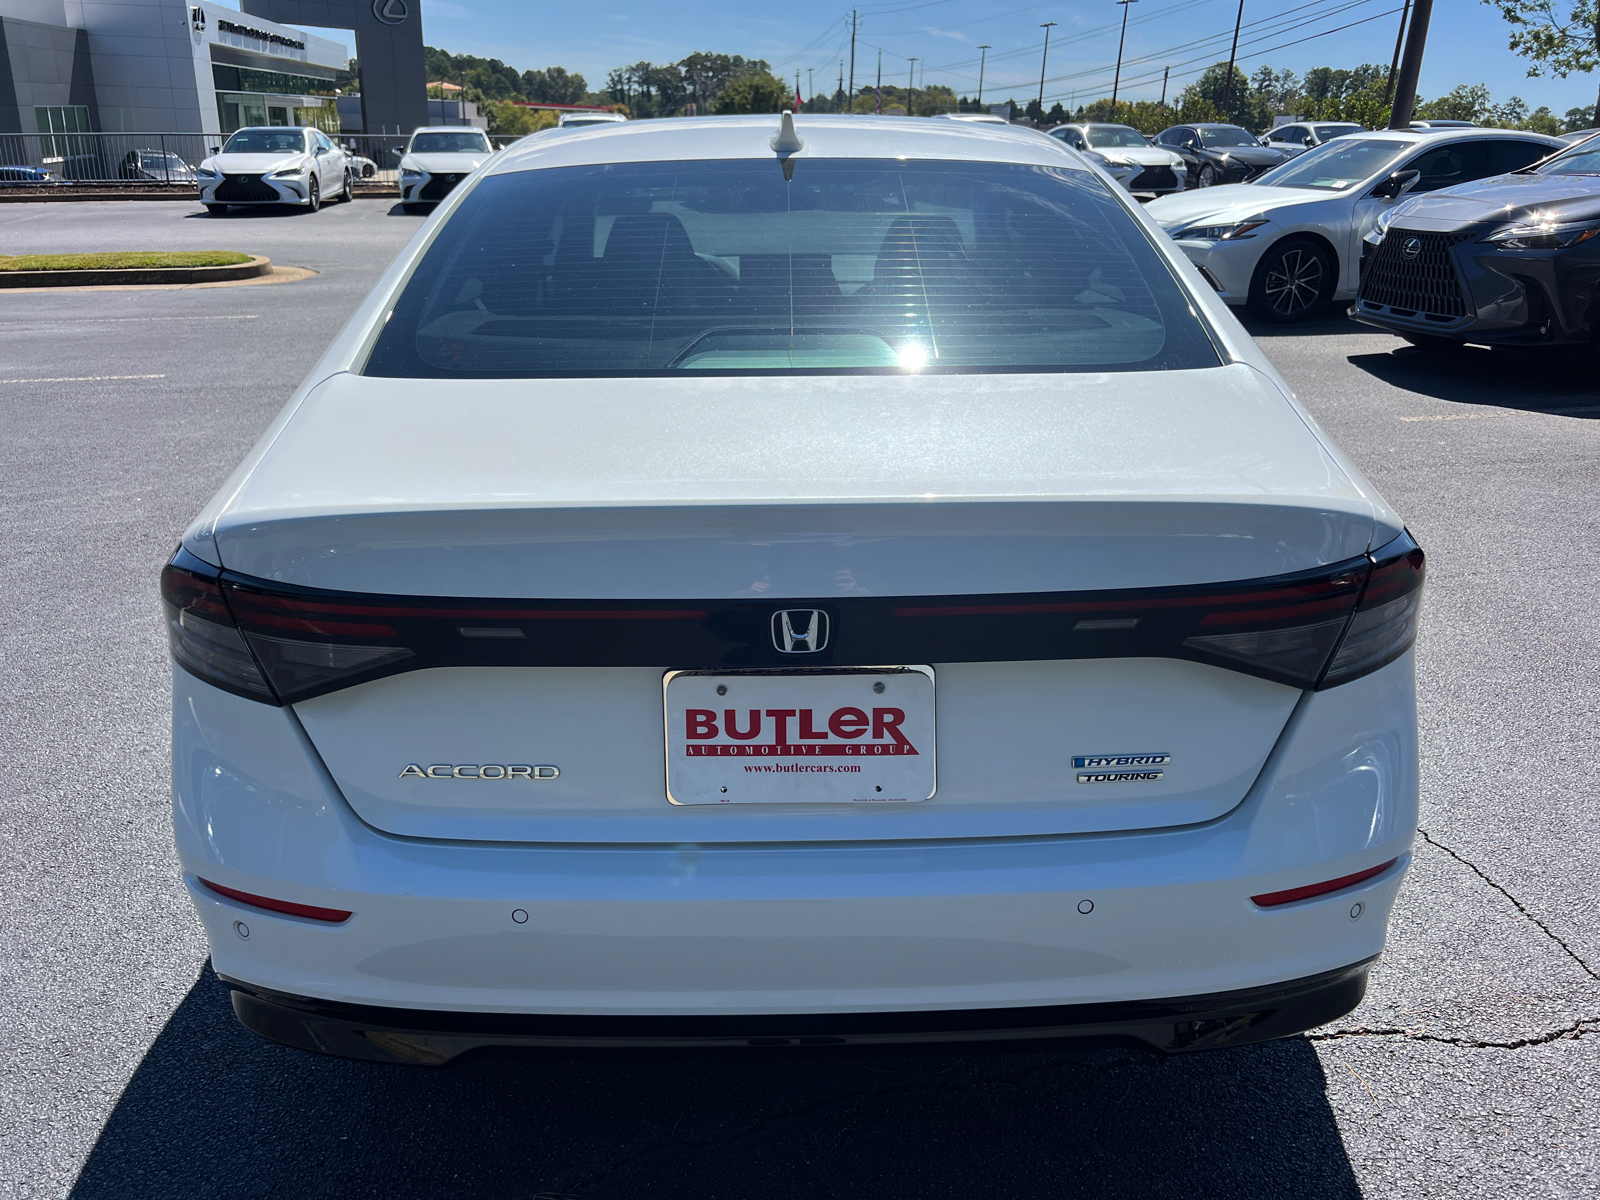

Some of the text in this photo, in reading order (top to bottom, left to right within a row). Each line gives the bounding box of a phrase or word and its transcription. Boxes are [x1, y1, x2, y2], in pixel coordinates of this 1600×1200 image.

[687, 744, 910, 755] AUTOMOTIVE GROUP
[1086, 755, 1166, 766] HYBRID
[398, 763, 561, 780] ACCORD
[743, 762, 861, 773] www.butlercars.com
[1083, 772, 1158, 782] TOURING
